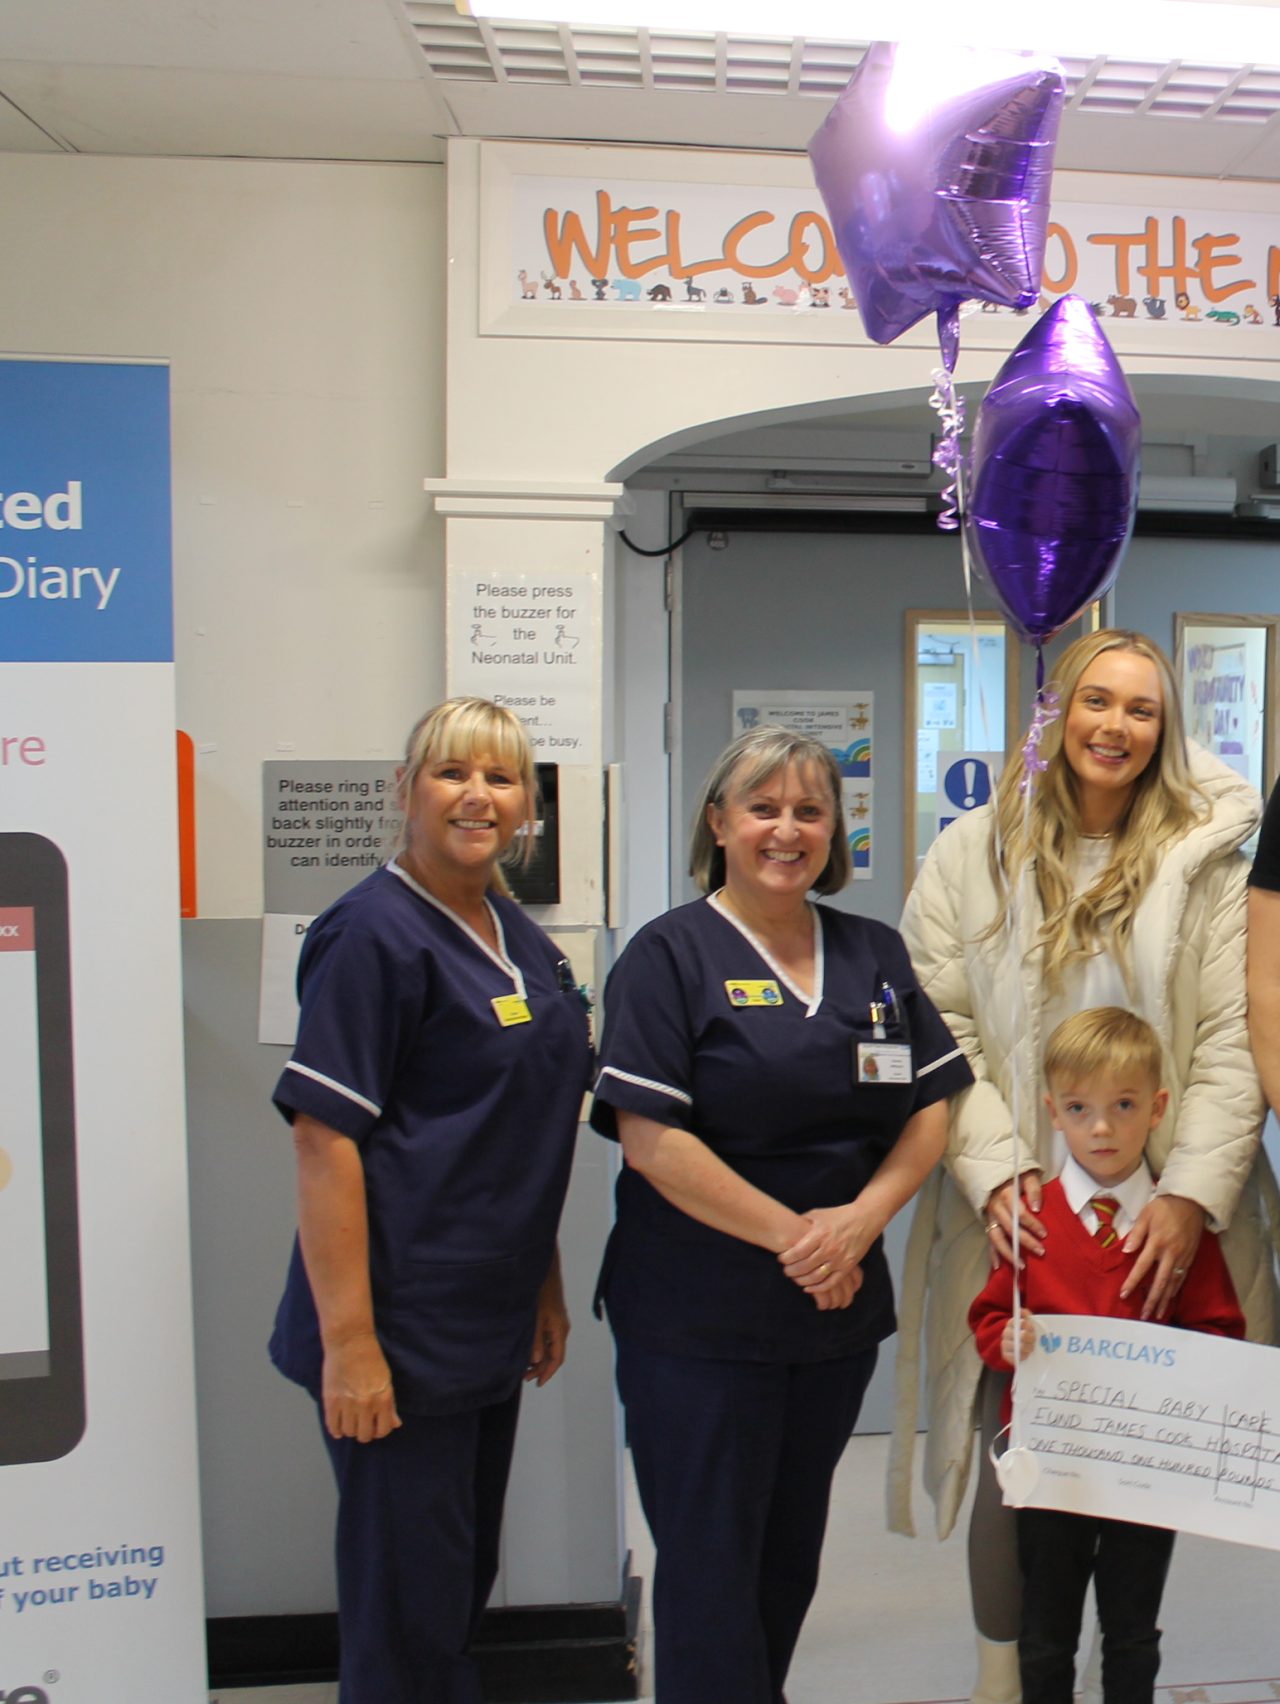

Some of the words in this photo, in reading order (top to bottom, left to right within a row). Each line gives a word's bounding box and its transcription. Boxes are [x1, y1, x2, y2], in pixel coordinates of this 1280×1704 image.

[543, 189, 846, 284] WELCO
[1041, 222, 1078, 294] O
[1086, 215, 1257, 304] THE
[0, 480, 83, 531] ed
[0, 556, 122, 610] Diary
[475, 583, 528, 597] Please
[532, 586, 573, 599] press
[473, 605, 496, 619] the
[501, 605, 552, 619] buzzer
[556, 605, 577, 619] for
[513, 628, 536, 640] the
[471, 651, 539, 664] Neonatal
[543, 651, 577, 664] Unit.
[493, 695, 536, 707] Please
[540, 694, 556, 706] be
[549, 736, 582, 749] busy.
[278, 779, 332, 793] Please
[338, 779, 369, 796] ring
[278, 799, 349, 811] attention
[354, 799, 384, 811] and
[272, 817, 311, 829] back
[315, 817, 373, 832] slightly
[378, 817, 402, 830] fro
[266, 835, 321, 848] buzzer
[326, 835, 340, 848] in
[345, 835, 382, 848] orde
[290, 856, 320, 867] can
[325, 853, 384, 869] identify
[1067, 1335, 1177, 1367] BARCLAYS
[1055, 1380, 1139, 1410] SPECIAL
[1158, 1397, 1208, 1422] BABY
[1229, 1410, 1272, 1433] CARE
[1034, 1407, 1082, 1429] FUND
[1094, 1417, 1145, 1439] JAMES
[1157, 1427, 1193, 1447] COOK
[1028, 1437, 1056, 1453] ONE
[33, 1544, 165, 1574] receiving
[12, 1584, 81, 1613] your
[88, 1575, 158, 1599] baby
